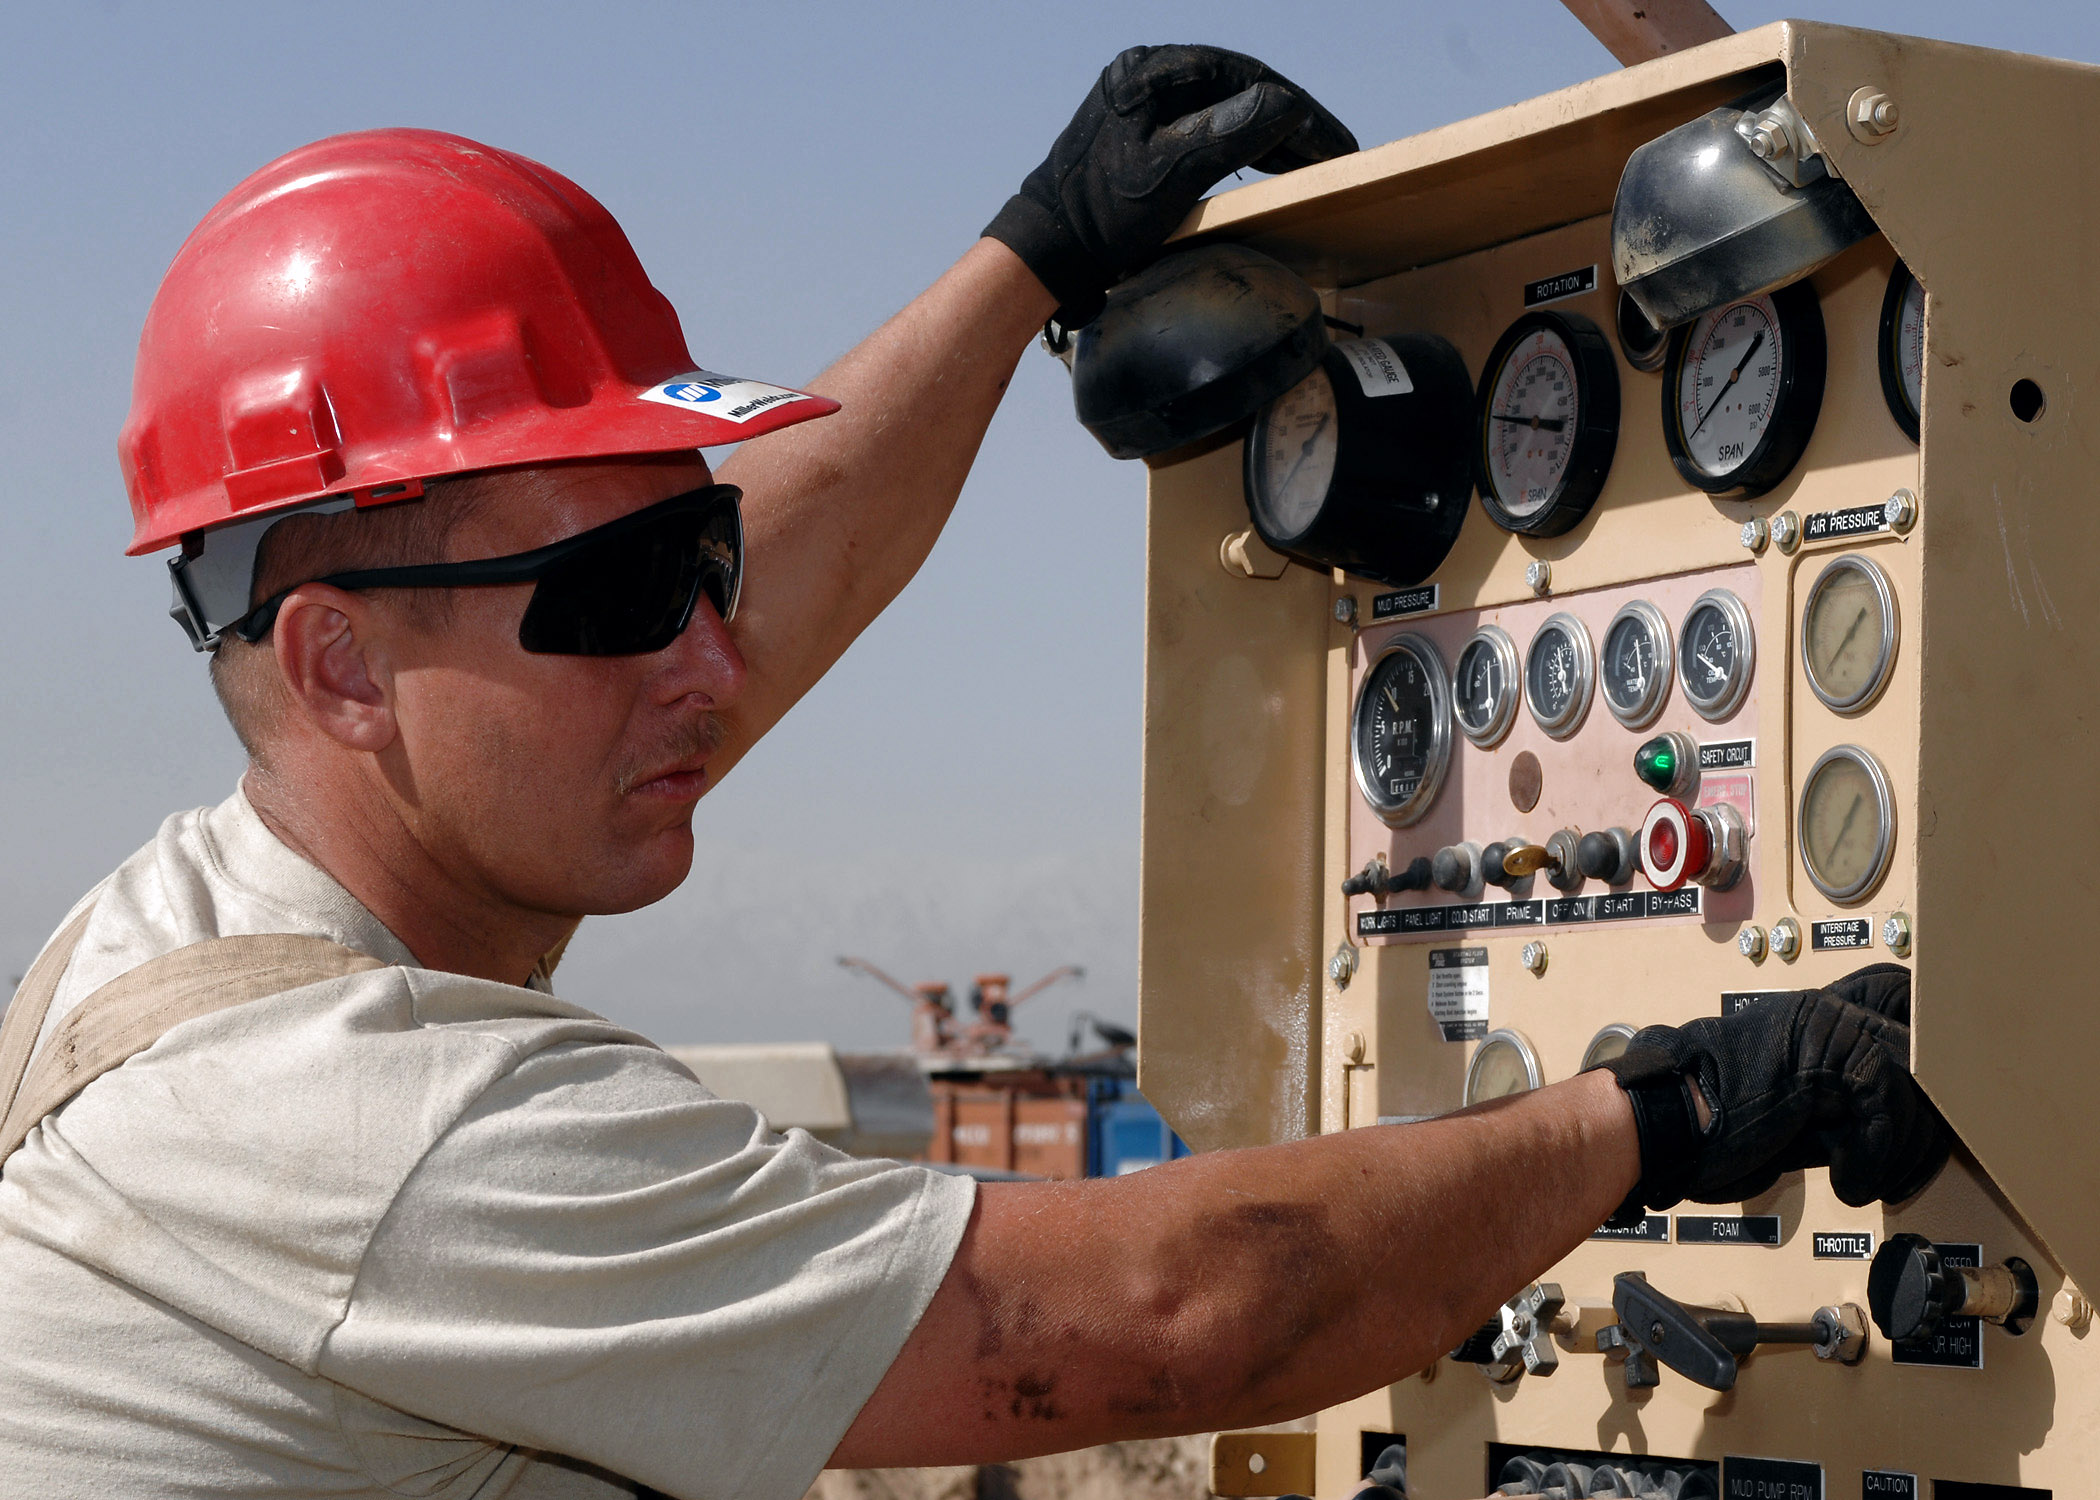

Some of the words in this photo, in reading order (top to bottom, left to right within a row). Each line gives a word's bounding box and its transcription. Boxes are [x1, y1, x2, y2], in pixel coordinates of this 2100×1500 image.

[1536, 275, 1580, 298] ROTATION
[1380, 360, 1400, 383] GAUGE
[1758, 365, 1770, 377] 5000
[1748, 403, 1760, 415] 6000
[1749, 420, 1758, 432] psi
[1718, 442, 1744, 461] SPAN
[1528, 487, 1547, 503] SPAN
[1810, 519, 1826, 534] AIR
[1830, 511, 1880, 531] PRESSURE
[1377, 599, 1392, 612] MUD
[1395, 592, 1430, 609] PRESSURE
[1408, 671, 1414, 684] 15
[1381, 720, 1386, 734] 5
[1386, 754, 1391, 769] 0
[1701, 749, 1724, 764] SAFETY
[1726, 746, 1748, 763] CIRCUIT
[1730, 783, 1747, 797] STOP
[1604, 898, 1634, 913] START
[1652, 894, 1692, 911] BY-PASS
[1405, 913, 1423, 926] PANEL
[1425, 911, 1442, 925] LIGHT
[1451, 909, 1468, 924] COLD
[1469, 908, 1490, 922] START
[1506, 905, 1531, 920] PRIME
[1360, 917, 1376, 930] WORK
[1377, 915, 1396, 929] LIGHTS
[1820, 921, 1860, 934] INTERSTAGE
[1823, 935, 1857, 947] PRESSURE
[1712, 1222, 1739, 1237] FOAM
[1817, 1237, 1866, 1254] THROTTLE
[1949, 1337, 1972, 1355] HIGH
[1732, 1479, 1753, 1498] MUD
[1757, 1481, 1786, 1499] PUMP
[1790, 1484, 1813, 1500] RPM
[1866, 1475, 1908, 1493] CAUTION
